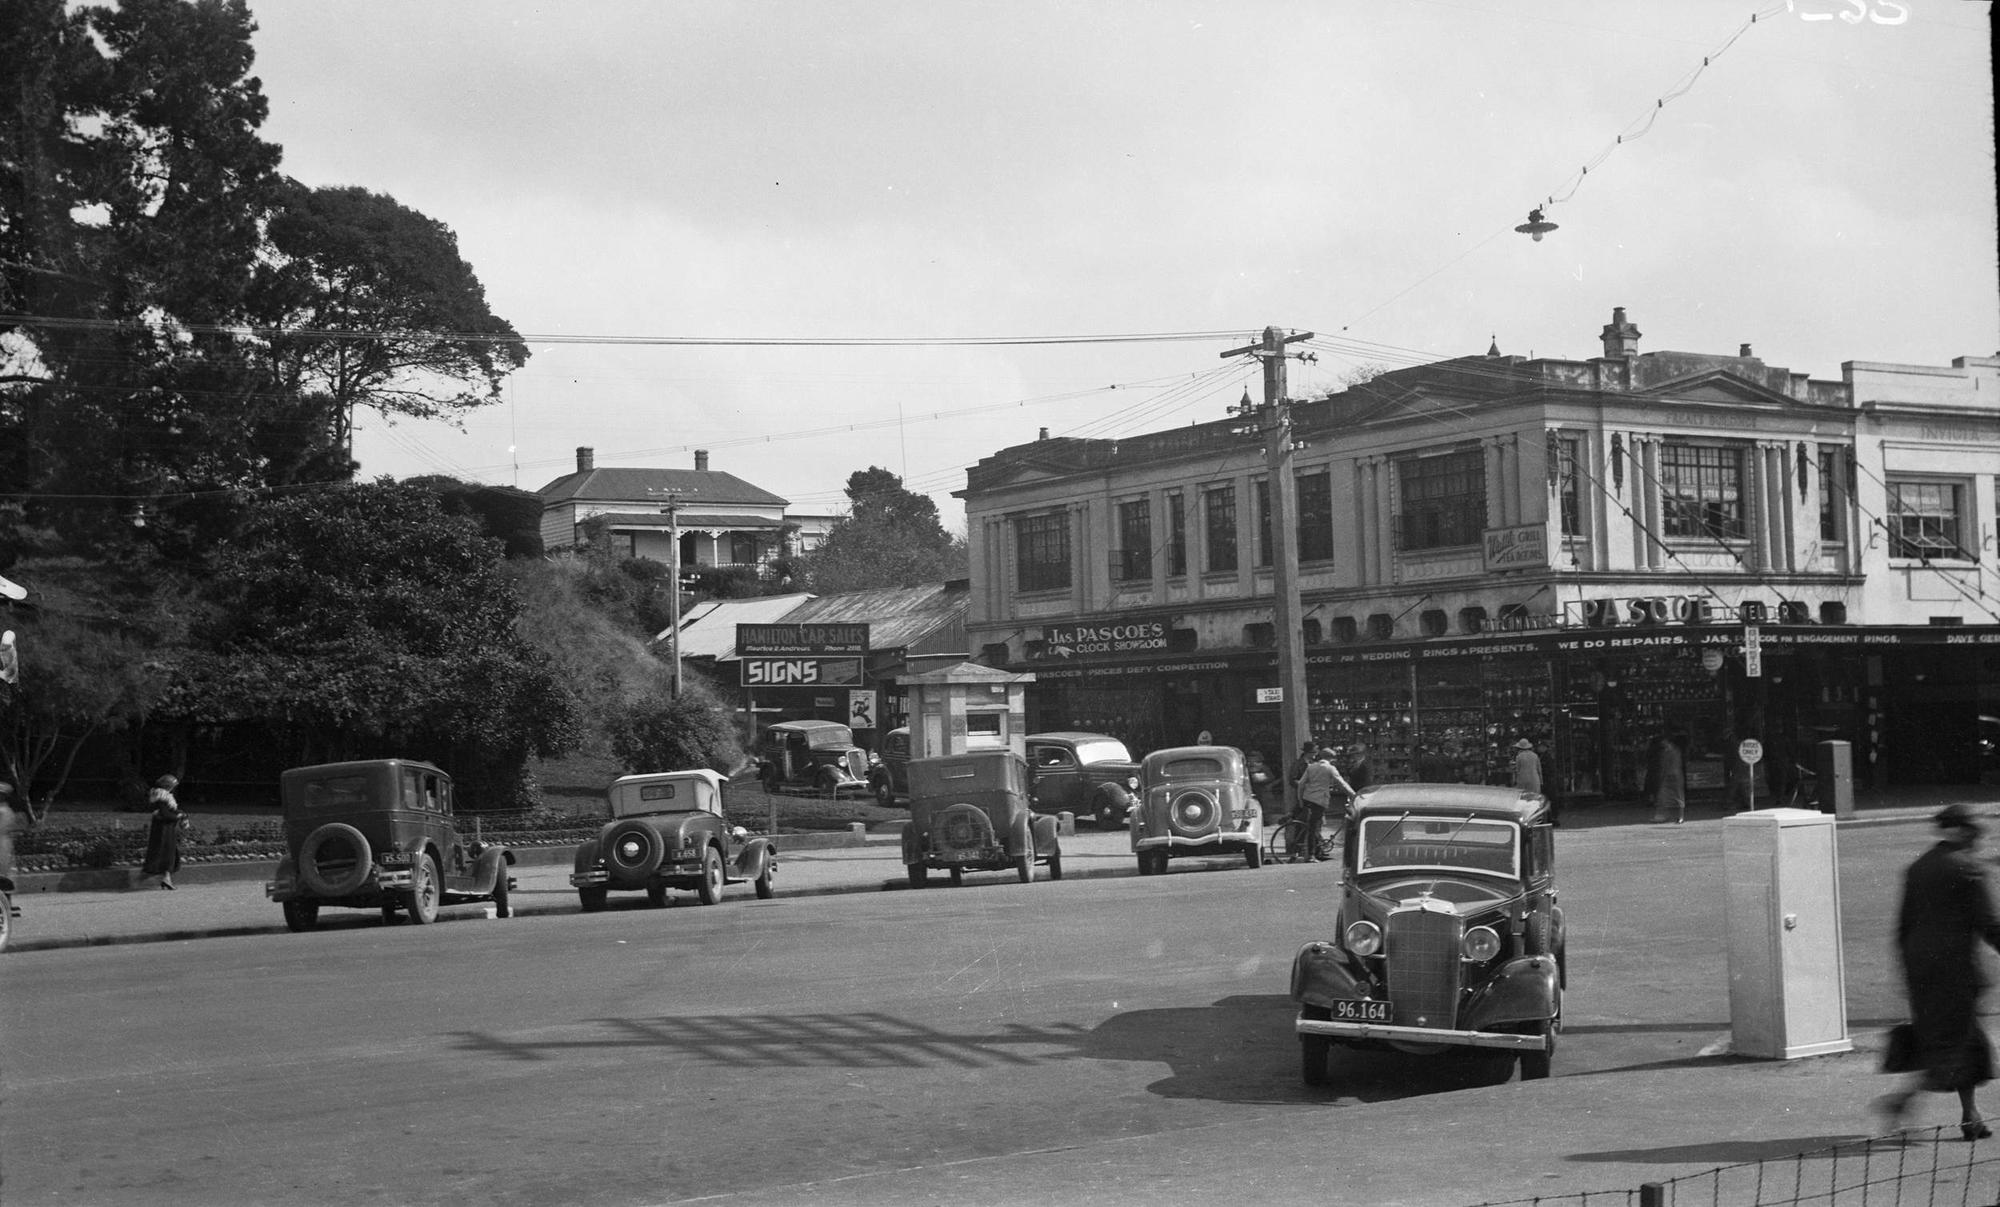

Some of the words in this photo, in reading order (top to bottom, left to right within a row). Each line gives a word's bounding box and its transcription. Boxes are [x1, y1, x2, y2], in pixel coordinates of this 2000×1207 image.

[1518, 529, 1541, 542] GRILL
[1582, 595, 1713, 626] PASCOE
[741, 628, 799, 644] HAMILTON
[801, 628, 827, 644] CAR
[829, 627, 865, 644] SALES
[1077, 622, 1164, 642] PASCOE'S
[1947, 634, 1975, 643] DAVE
[1077, 642, 1110, 653] CLOCK
[1114, 638, 1167, 651] SHOWROOM
[1558, 641, 1579, 649] WE
[1584, 640, 1605, 648] DO
[1611, 636, 1689, 647] REPAIRS.
[1797, 635, 1858, 643] ENGAGEMENT
[1361, 650, 1411, 660] WEDDING
[1423, 648, 1459, 657] RINGS
[749, 660, 817, 684] SIGNS
[1128, 665, 1153, 673] DEFY
[1157, 662, 1229, 672] COMPETITION
[1337, 1001, 1386, 1020] 96.164
